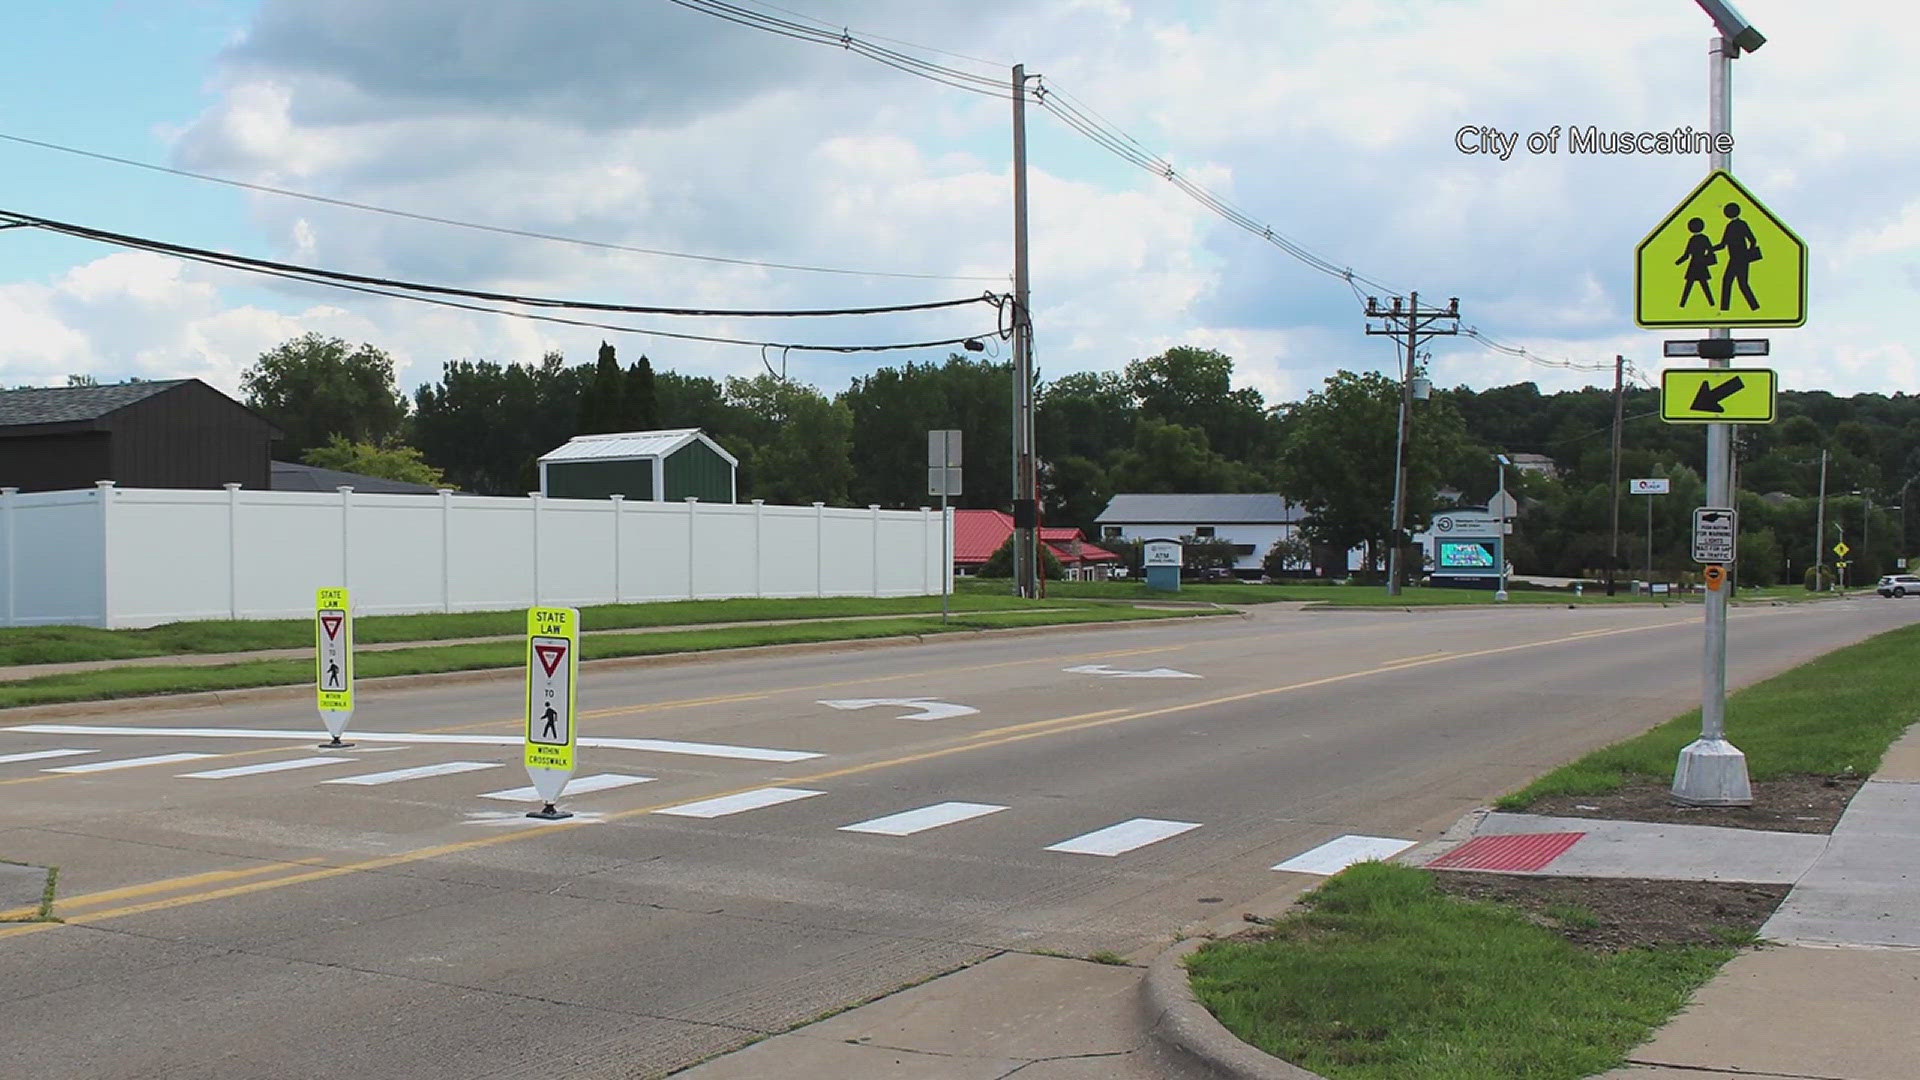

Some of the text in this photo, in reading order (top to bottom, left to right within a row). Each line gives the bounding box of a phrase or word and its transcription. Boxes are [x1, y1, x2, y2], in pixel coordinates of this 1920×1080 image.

[321, 590, 341, 599] STATE
[536, 611, 566, 623] STATE
[541, 624, 561, 635] LAW
[545, 688, 555, 698] TO
[538, 746, 560, 754] WITHIN
[529, 755, 567, 766] CROSSWALK
